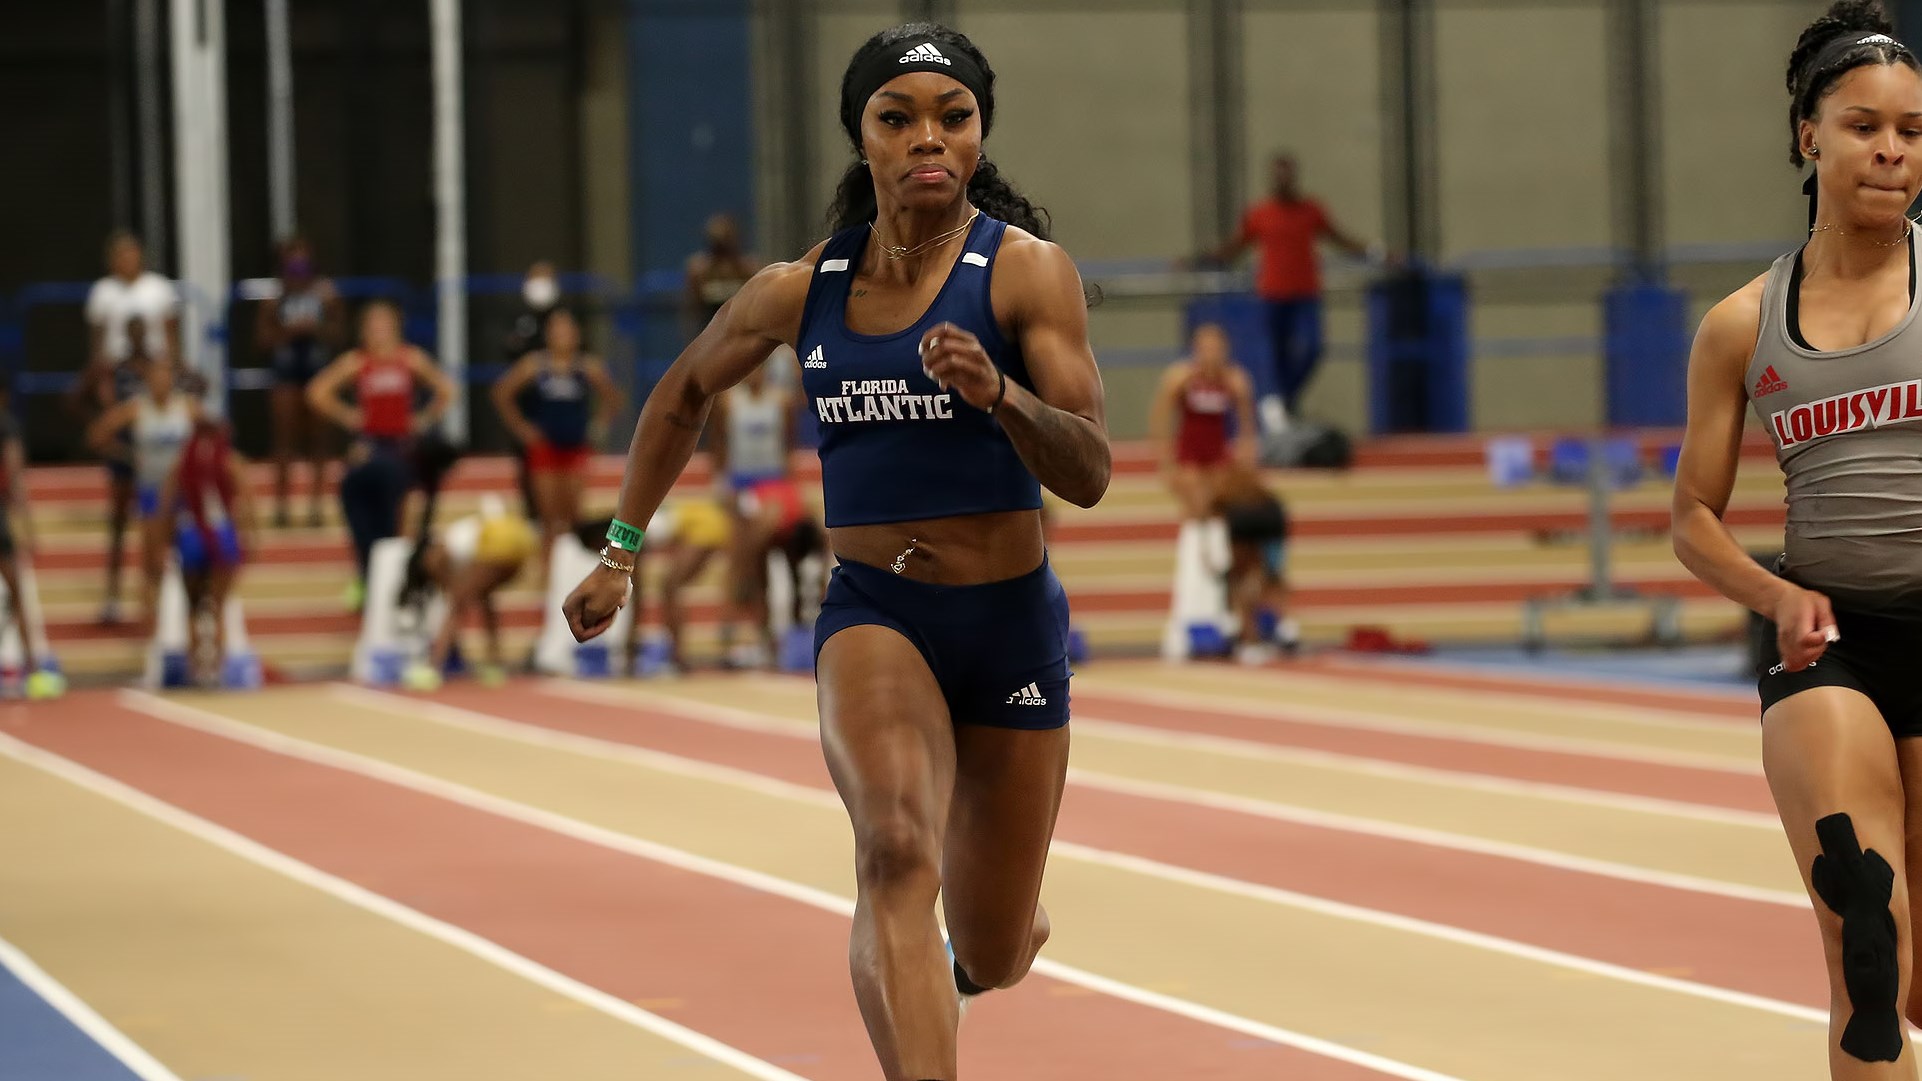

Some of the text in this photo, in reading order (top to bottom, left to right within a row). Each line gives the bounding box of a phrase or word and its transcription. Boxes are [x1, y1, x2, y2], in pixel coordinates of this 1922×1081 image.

[898, 52, 951, 66] adidas
[804, 358, 827, 369] adidas
[841, 379, 909, 395] FLORIDA
[1754, 380, 1788, 398] adidas
[816, 394, 953, 423] ATLANTIC
[1770, 378, 1922, 450] LOUISVIL
